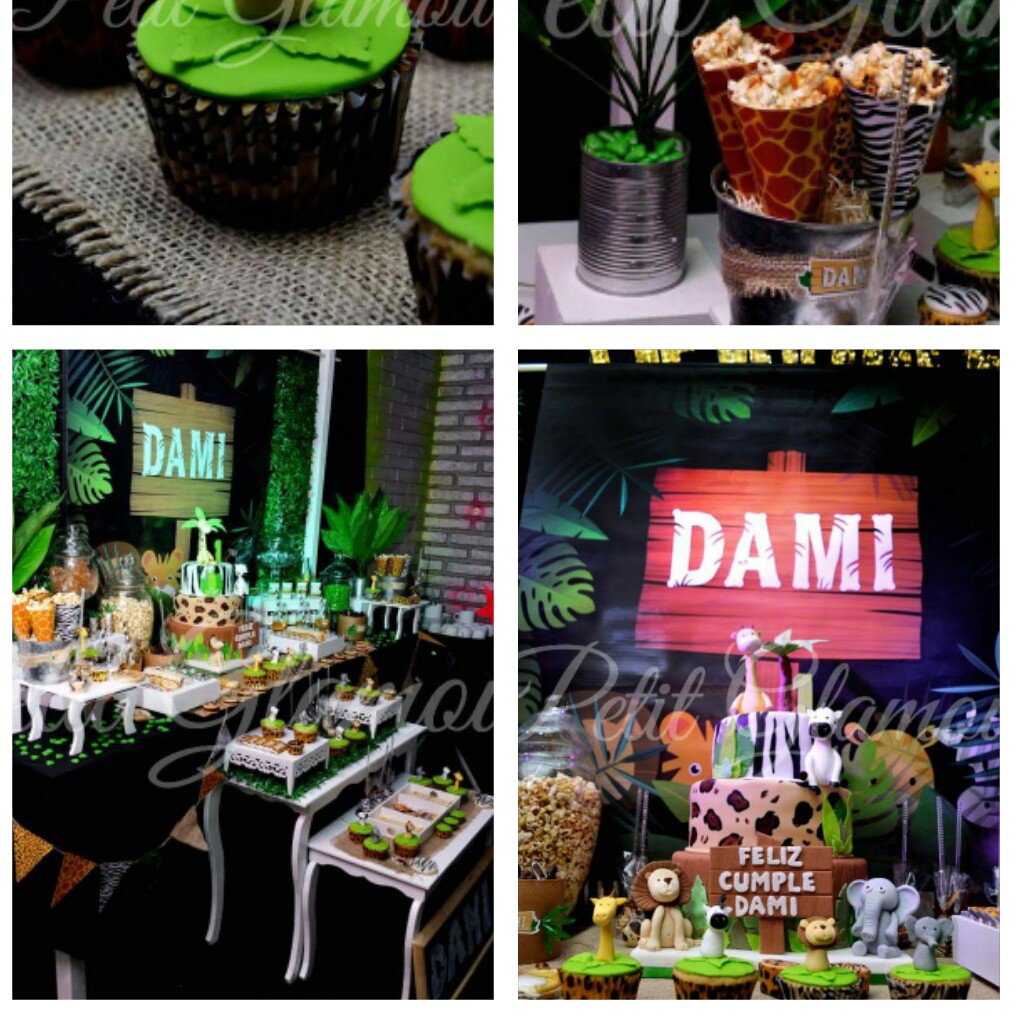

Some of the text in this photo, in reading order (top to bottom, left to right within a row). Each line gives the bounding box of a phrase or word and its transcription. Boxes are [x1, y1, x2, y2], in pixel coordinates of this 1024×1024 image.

[822, 266, 869, 287] DAM
[141, 422, 227, 479] DAMI
[666, 508, 896, 592] DAMI
[738, 845, 804, 867] FELIZ
[719, 870, 816, 893] CUMPLE
[734, 895, 798, 916] DAMI
